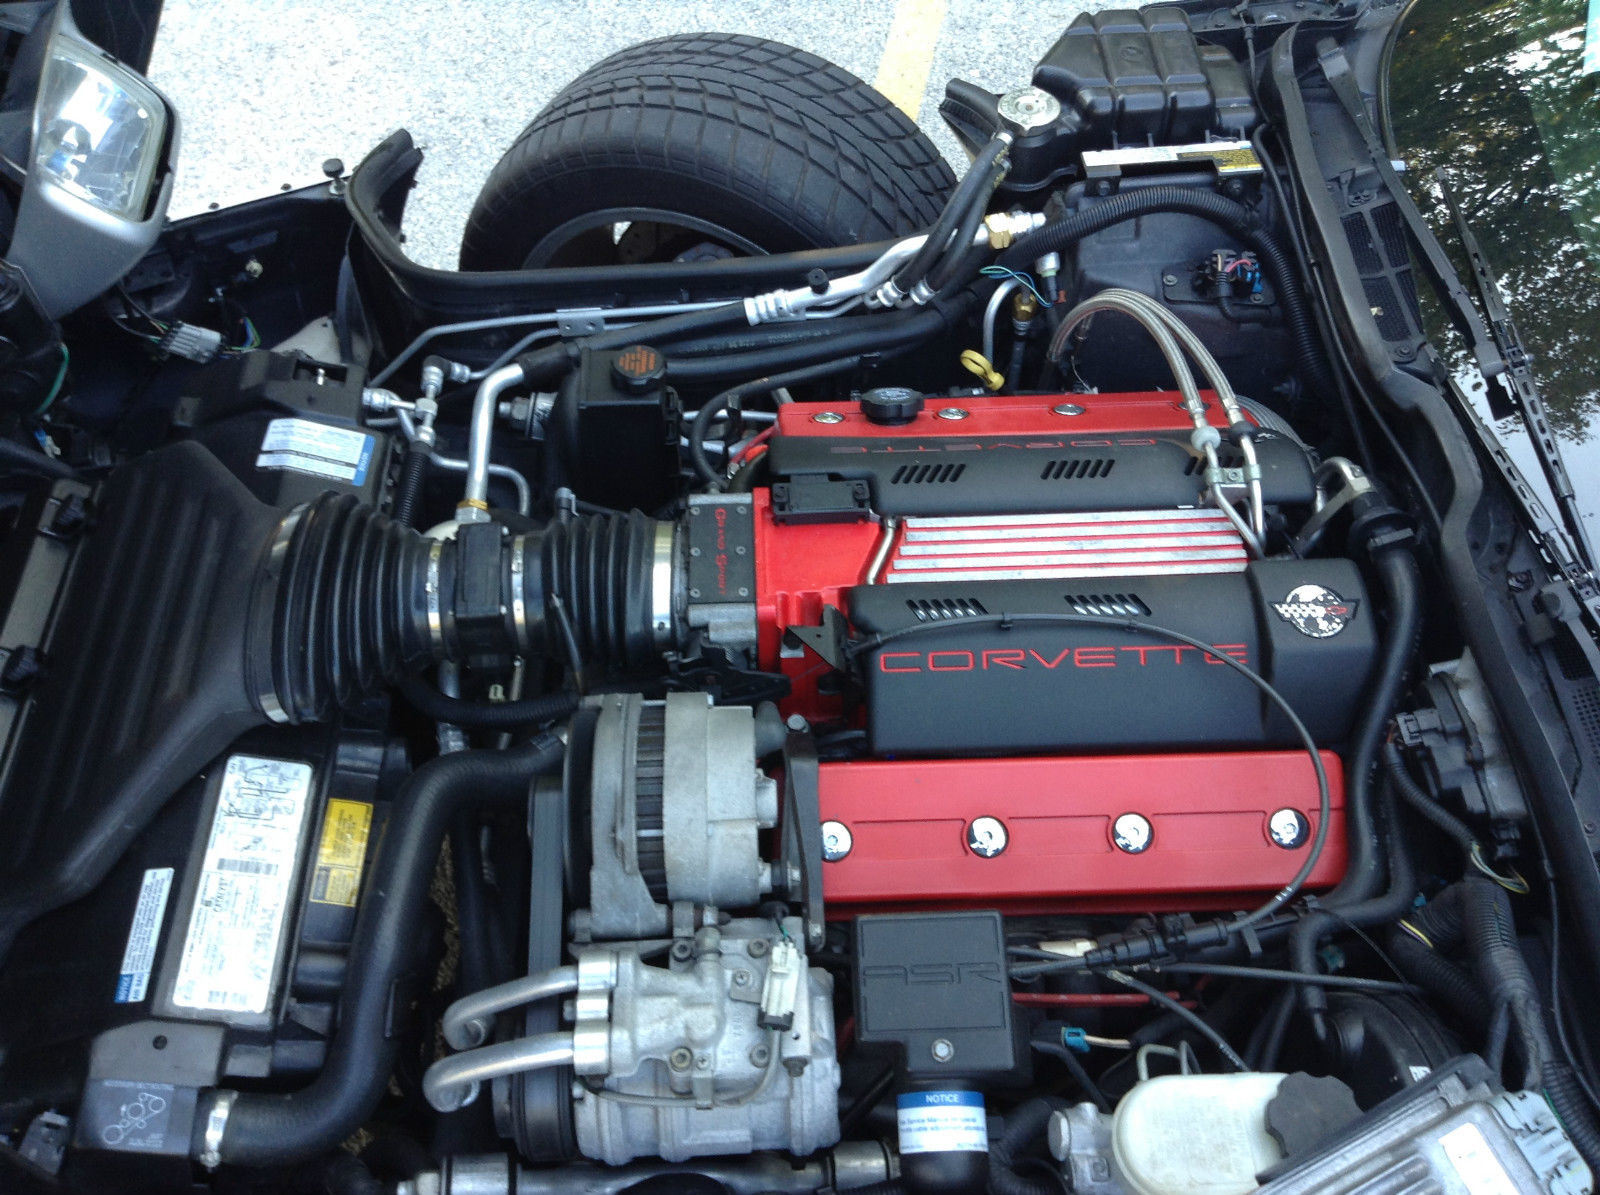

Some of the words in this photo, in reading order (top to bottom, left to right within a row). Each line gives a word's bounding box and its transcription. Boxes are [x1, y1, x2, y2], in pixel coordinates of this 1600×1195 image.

[879, 643, 1249, 673] CORVETTE
[863, 961, 1002, 987] ASR
[925, 1093, 959, 1104] NOTICE
